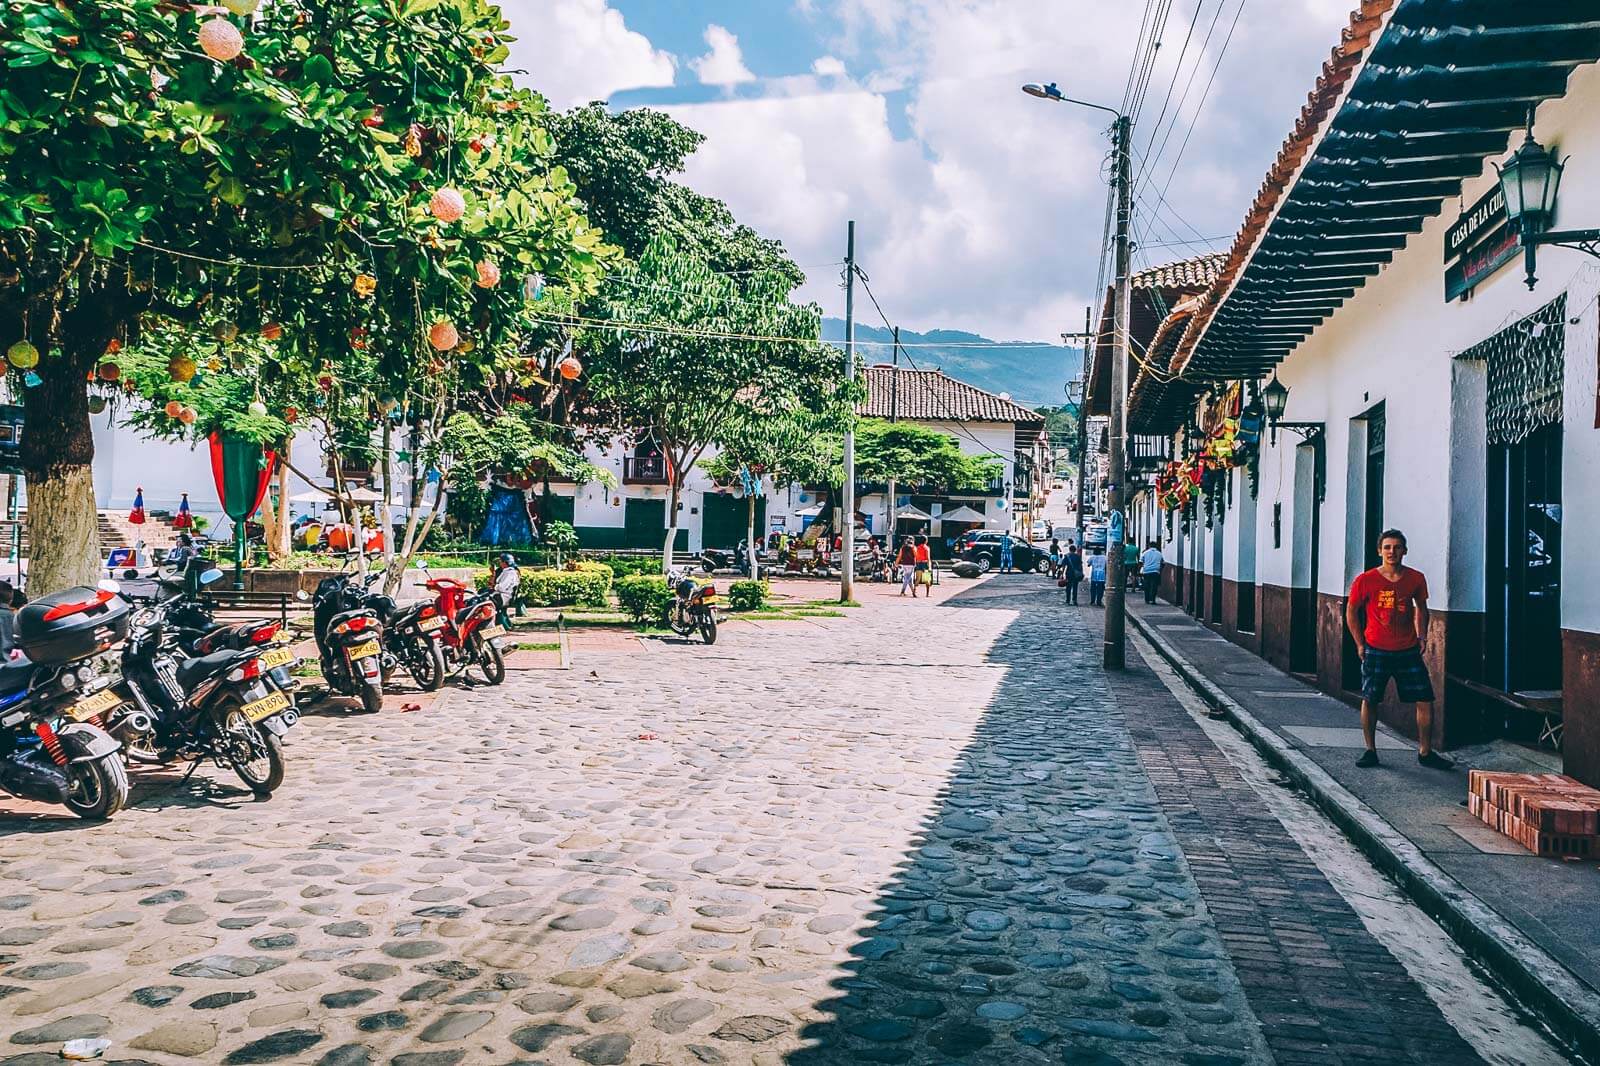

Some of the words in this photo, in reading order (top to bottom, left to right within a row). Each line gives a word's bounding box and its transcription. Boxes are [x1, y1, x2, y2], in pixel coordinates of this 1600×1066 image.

[1451, 220, 1468, 249] CASA
[1468, 211, 1479, 235] DE
[1479, 203, 1489, 226] LA
[1489, 190, 1505, 216] CUL
